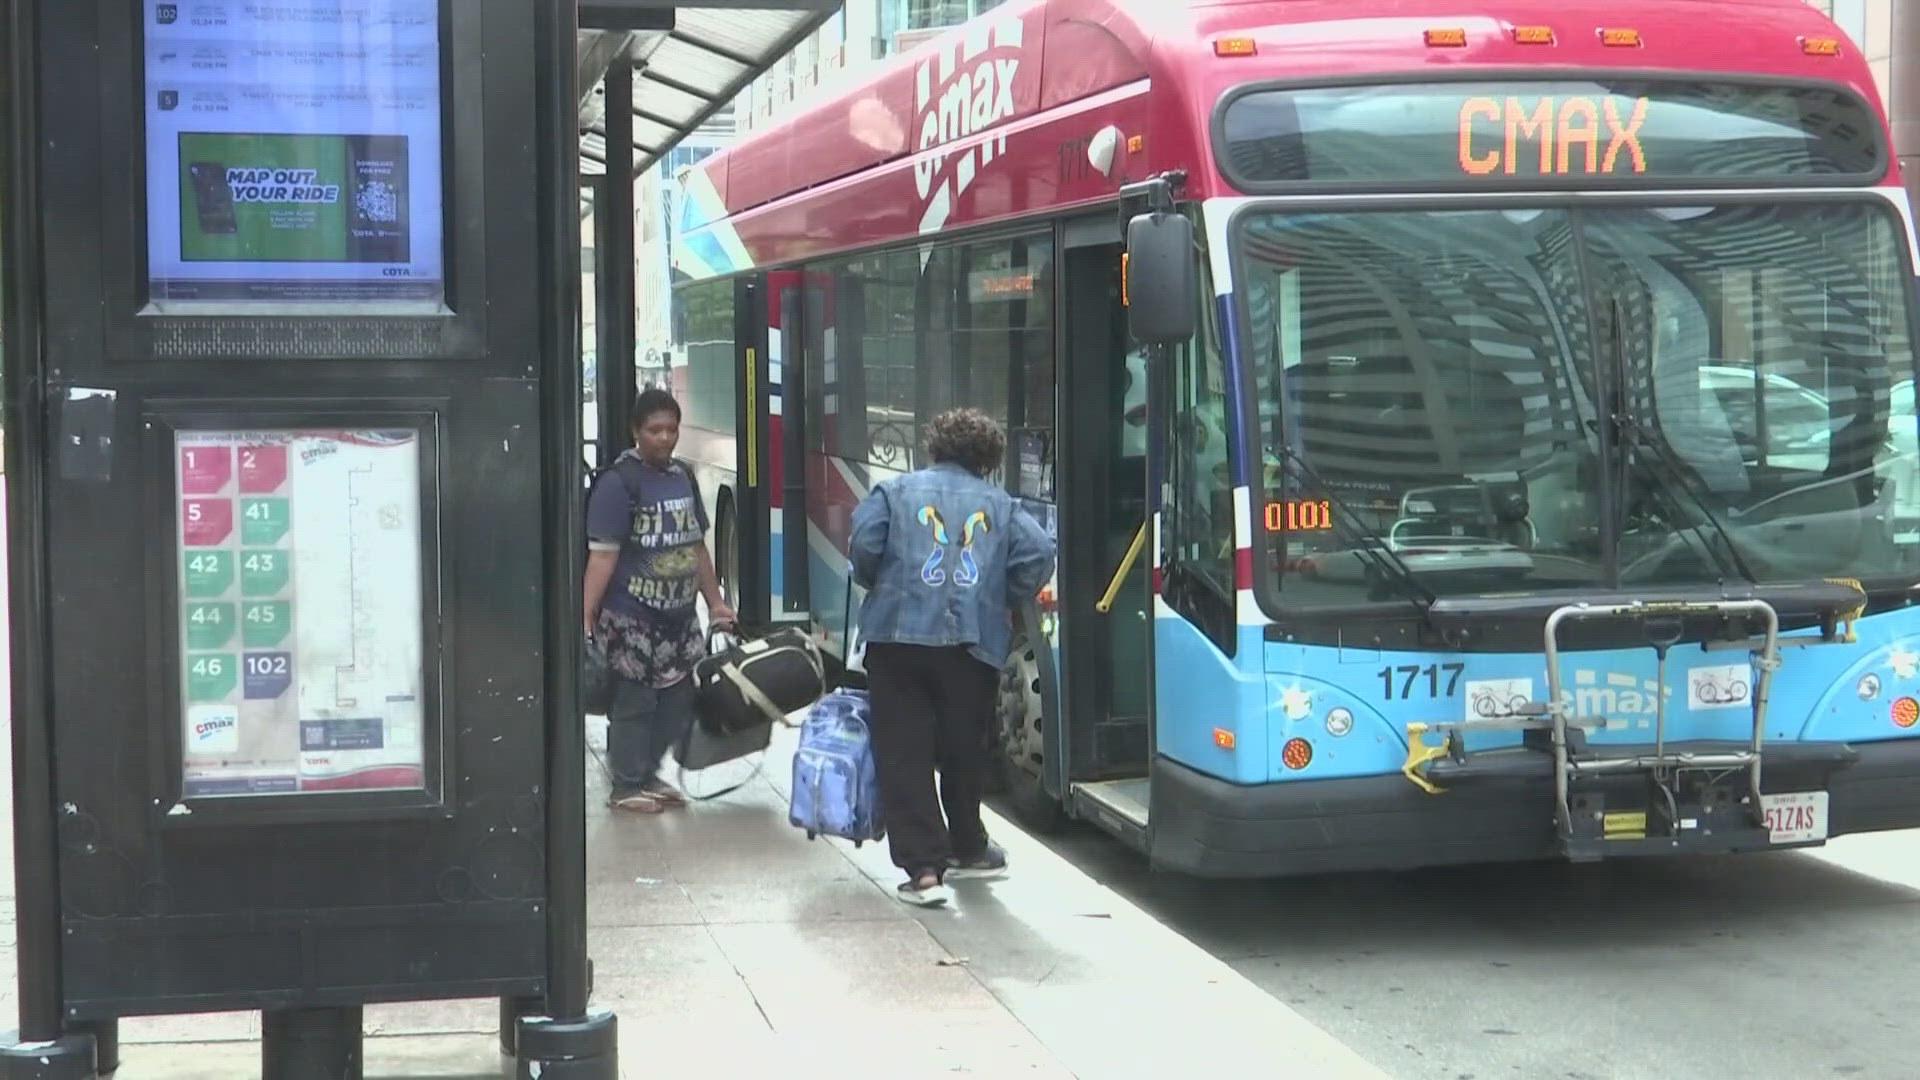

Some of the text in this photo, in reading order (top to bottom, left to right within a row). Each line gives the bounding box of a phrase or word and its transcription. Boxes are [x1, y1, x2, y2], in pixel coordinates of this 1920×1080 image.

[157, 7, 177, 19] 102
[914, 59, 1019, 200] cmax
[1458, 97, 1649, 175] CMAX
[227, 170, 315, 185] MAP OUT
[233, 186, 338, 201] YOUR RIDE
[382, 267, 410, 277] COTA
[186, 452, 195, 468] 1
[243, 452, 256, 468] 2
[188, 504, 201, 520] 5
[246, 503, 270, 520] 41
[641, 535, 658, 548] OF
[190, 556, 218, 573] 42
[245, 555, 274, 572] 43
[628, 576, 678, 600] HOLY
[192, 607, 222, 624] 44
[248, 606, 275, 622] 45
[192, 659, 222, 675] 46
[247, 658, 287, 674] 102
[1377, 663, 1465, 700] 1717
[195, 717, 233, 734] cmax
[1765, 806, 1814, 832] 51ZAS
